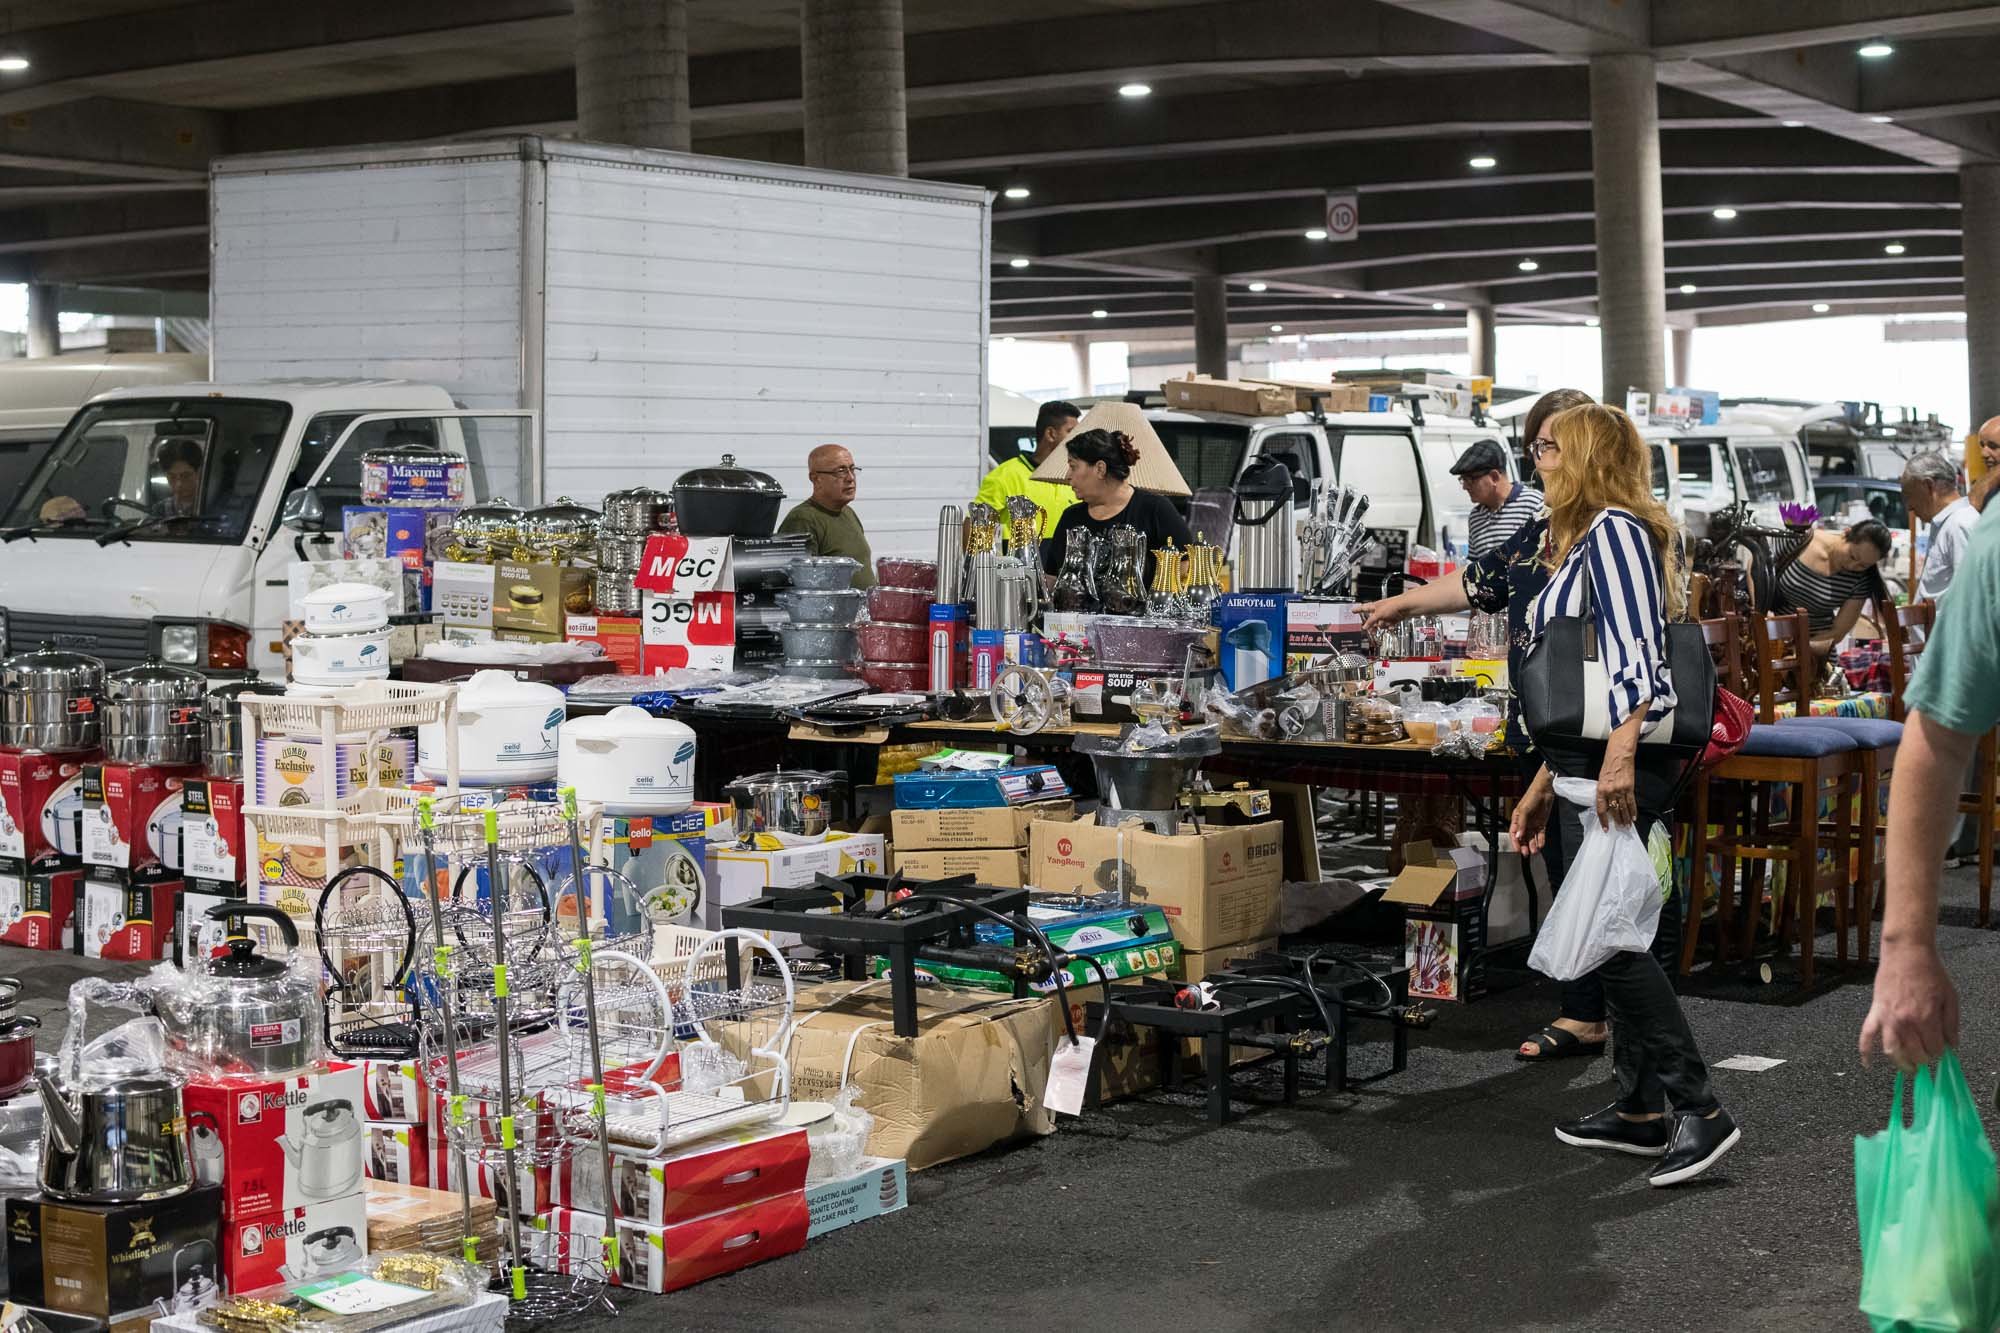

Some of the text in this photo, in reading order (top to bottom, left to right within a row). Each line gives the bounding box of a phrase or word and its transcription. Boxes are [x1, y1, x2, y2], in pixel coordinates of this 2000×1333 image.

[1335, 211, 1350, 226] 10
[391, 465, 443, 478] Maxima
[501, 566, 529, 574] INSULATED
[648, 556, 716, 578] MGC
[515, 573, 531, 581] FLASK
[1226, 598, 1277, 608] AIRPOT4.0L
[651, 602, 722, 625] MGC
[568, 624, 596, 632] HOT-STEAM
[503, 634, 530, 642] INSULATED
[1076, 674, 1104, 682] HUOCHU
[1376, 668, 1386, 677] tle
[1107, 679, 1150, 688] SOUP PO
[282, 746, 308, 760] JUMBO
[359, 747, 393, 766] JBO
[274, 759, 316, 773] Exclusive
[350, 767, 404, 783] Excsive
[187, 790, 206, 801] STEEL
[672, 818, 704, 832] CHEF
[630, 827, 652, 838] cello
[1058, 843, 1071, 851] YR
[266, 865, 282, 873] cello
[32, 883, 41, 909] STEEL
[282, 888, 306, 901] JUMBO
[136, 891, 144, 916] STEEL
[275, 900, 312, 914] Exclusiv
[254, 1025, 280, 1033] ZEBRA
[263, 1089, 307, 1110] Kettle
[807, 1192, 840, 1207] DIE-CASTING
[830, 1196, 855, 1210] COATING
[821, 1213, 836, 1223] CAKE
[837, 1210, 848, 1218] PAN
[849, 1205, 859, 1215] SET
[264, 1219, 307, 1241] Kettle
[111, 1240, 175, 1265] Whistling Kettle
